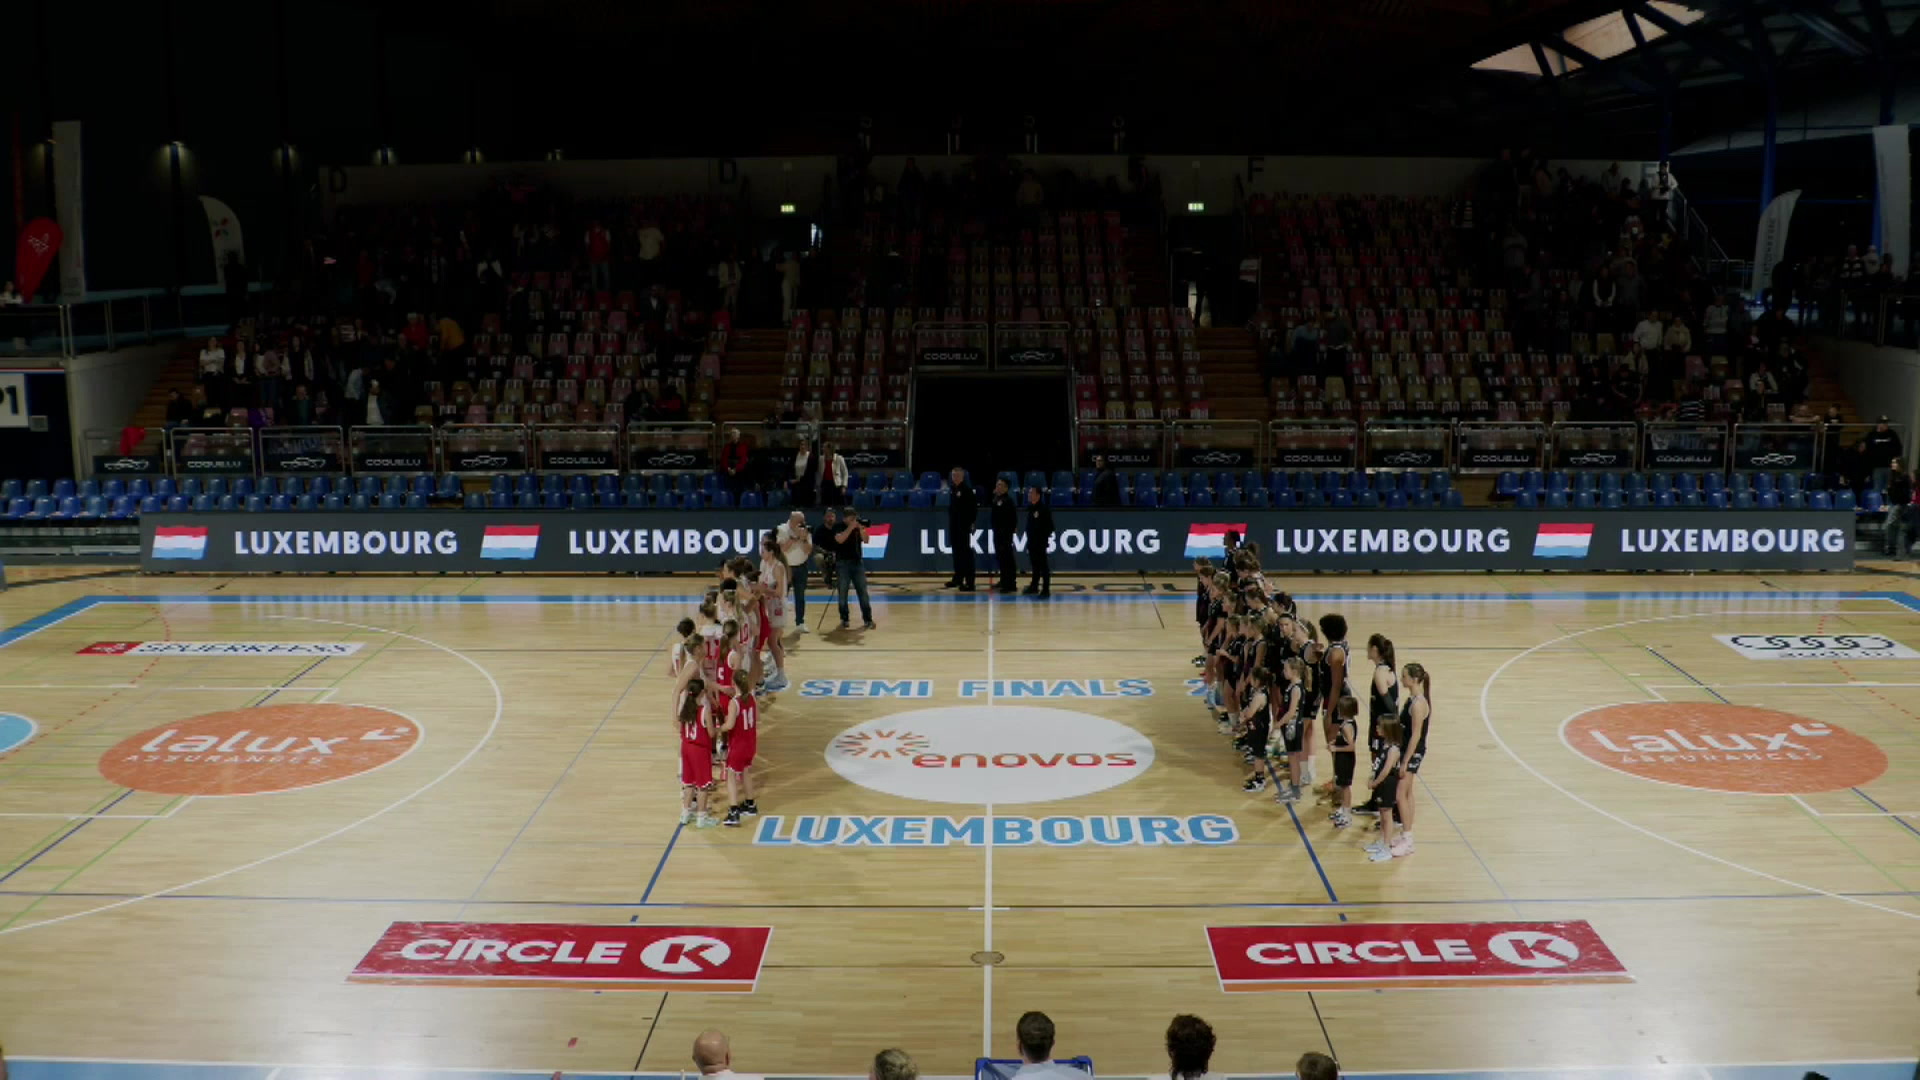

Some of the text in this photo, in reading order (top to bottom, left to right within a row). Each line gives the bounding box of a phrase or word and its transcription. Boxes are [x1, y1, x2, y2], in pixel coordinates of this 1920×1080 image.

[0, 385, 19, 415] 1
[234, 529, 458, 555] LUXEMBOURG
[569, 528, 773, 555] LUXEMBOU
[1276, 528, 1511, 553] LUXEMBOURG
[1620, 528, 1846, 553] LUXEMBOURG
[799, 679, 932, 697] SEMI
[958, 678, 1154, 697] FINALS
[140, 729, 348, 755] lalux
[1589, 729, 1810, 752] lalux
[911, 752, 1138, 769] enovos
[754, 815, 1239, 846] LUXEMBOURG
[400, 938, 628, 964] CIRCLE
[1245, 939, 1477, 965] CIRCLE
